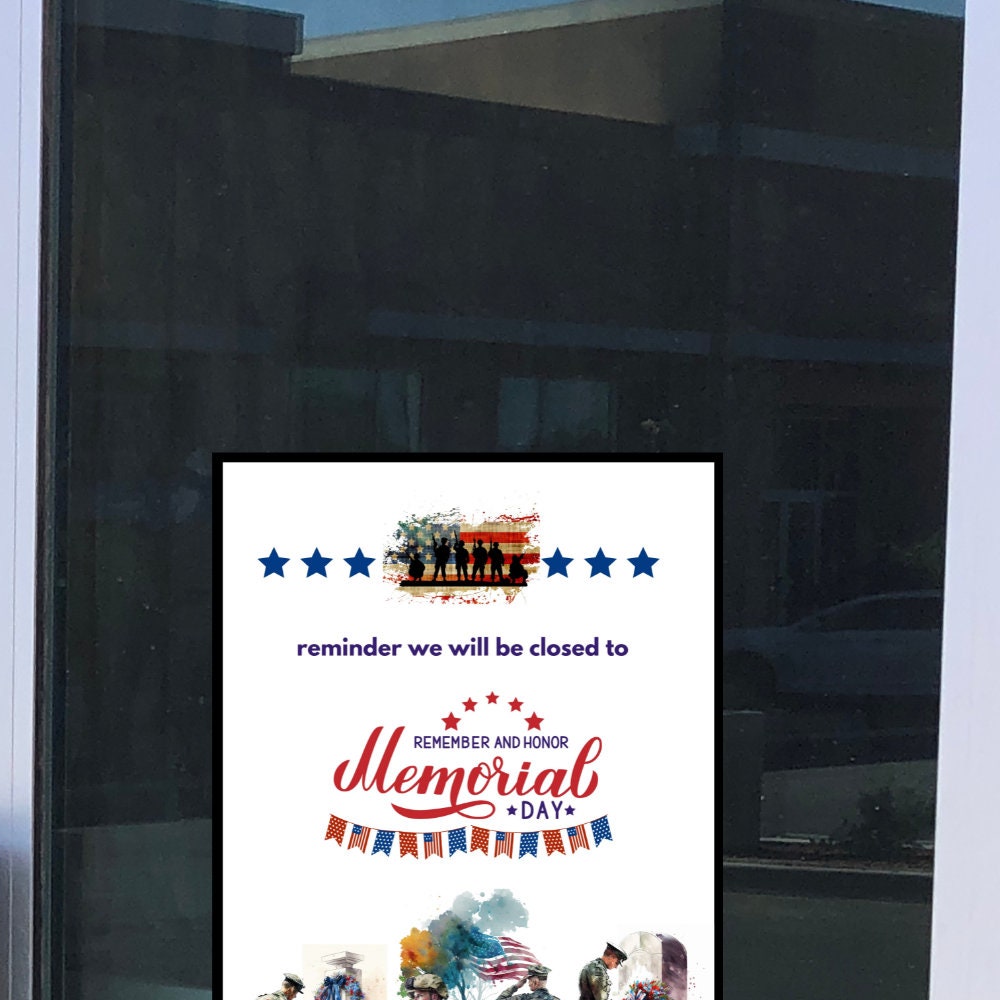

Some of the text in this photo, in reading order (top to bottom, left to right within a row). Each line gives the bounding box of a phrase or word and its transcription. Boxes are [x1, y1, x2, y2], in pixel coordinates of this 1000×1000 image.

[298, 637, 629, 657] reminder we will be closed to
[413, 735, 569, 749] REMEMBER AND HONOR
[333, 726, 603, 820] Memorial
[521, 800, 564, 820] DAY
